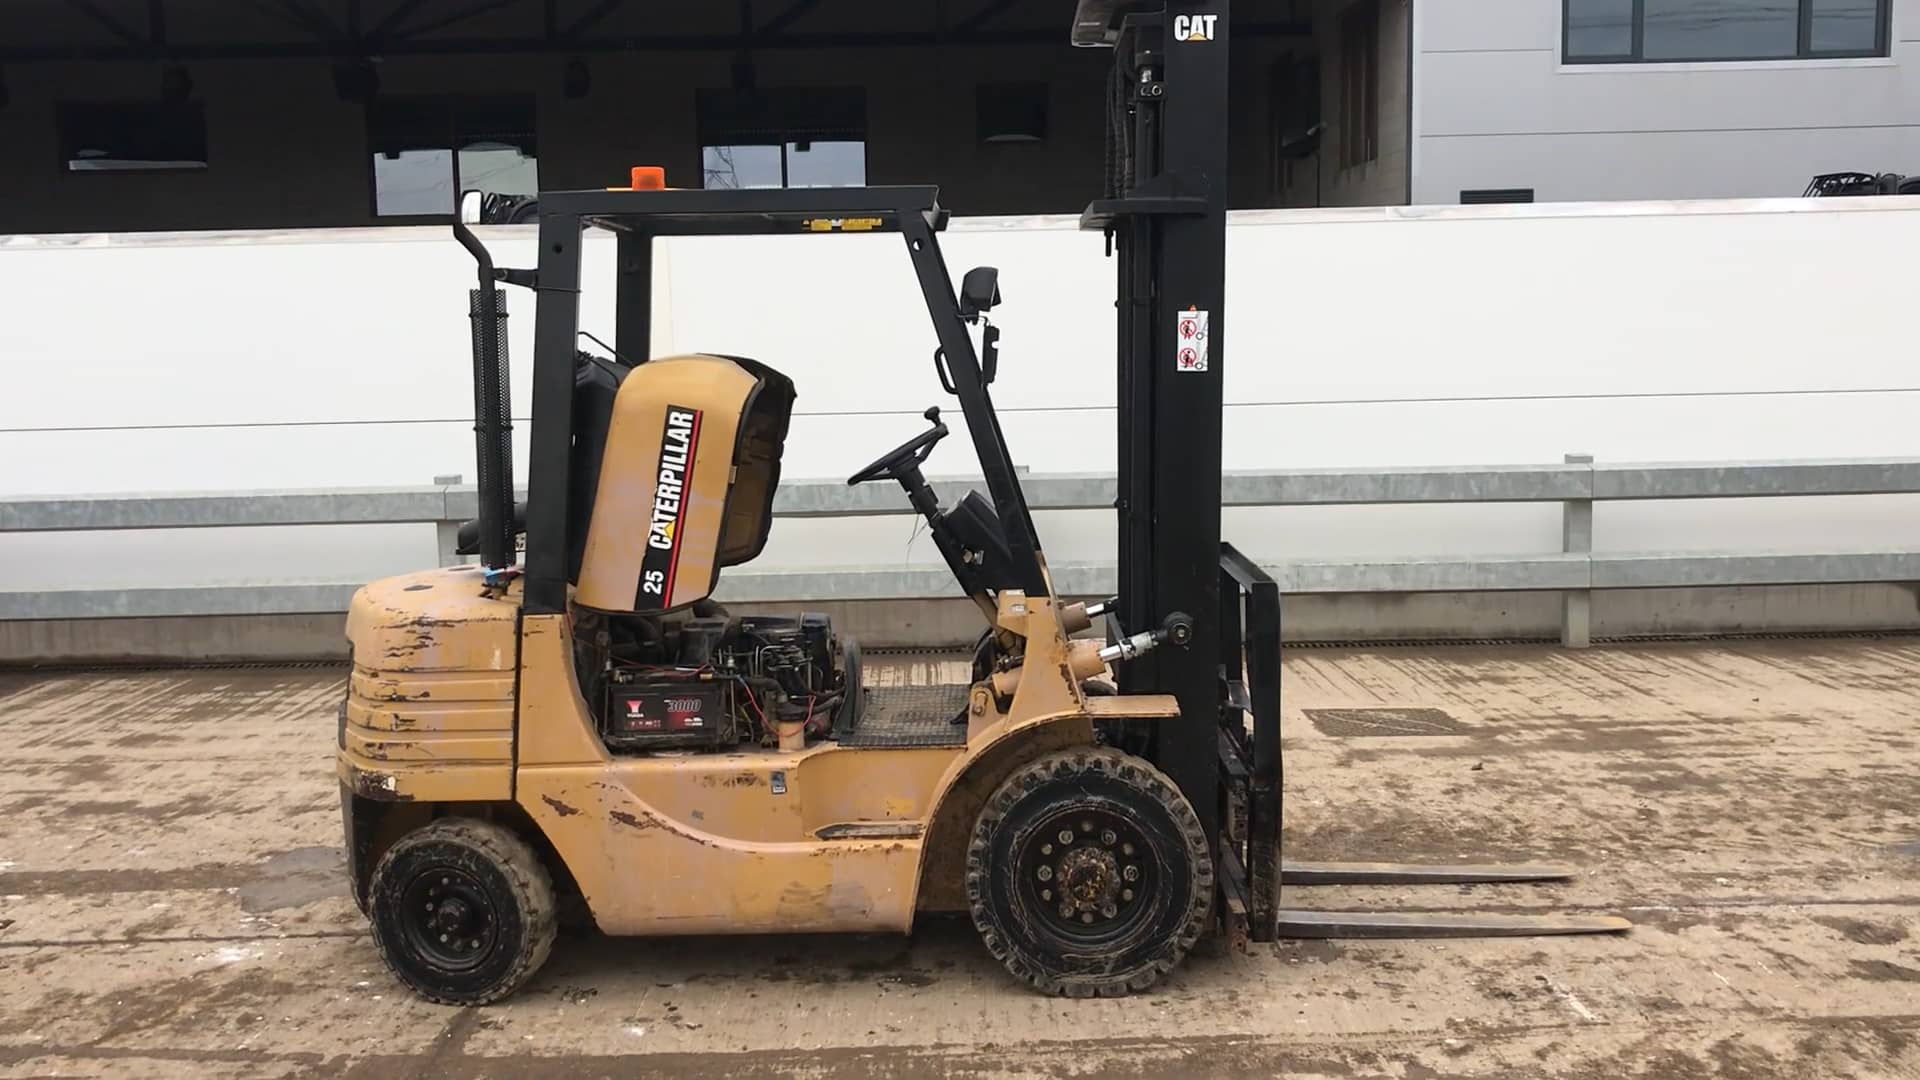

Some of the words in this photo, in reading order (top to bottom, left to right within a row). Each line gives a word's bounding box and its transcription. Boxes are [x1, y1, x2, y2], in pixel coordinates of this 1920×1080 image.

[1174, 14, 1218, 41] CAT
[649, 411, 694, 550] CATERPILLAR
[643, 570, 664, 595] 25
[667, 699, 702, 712] 3000
